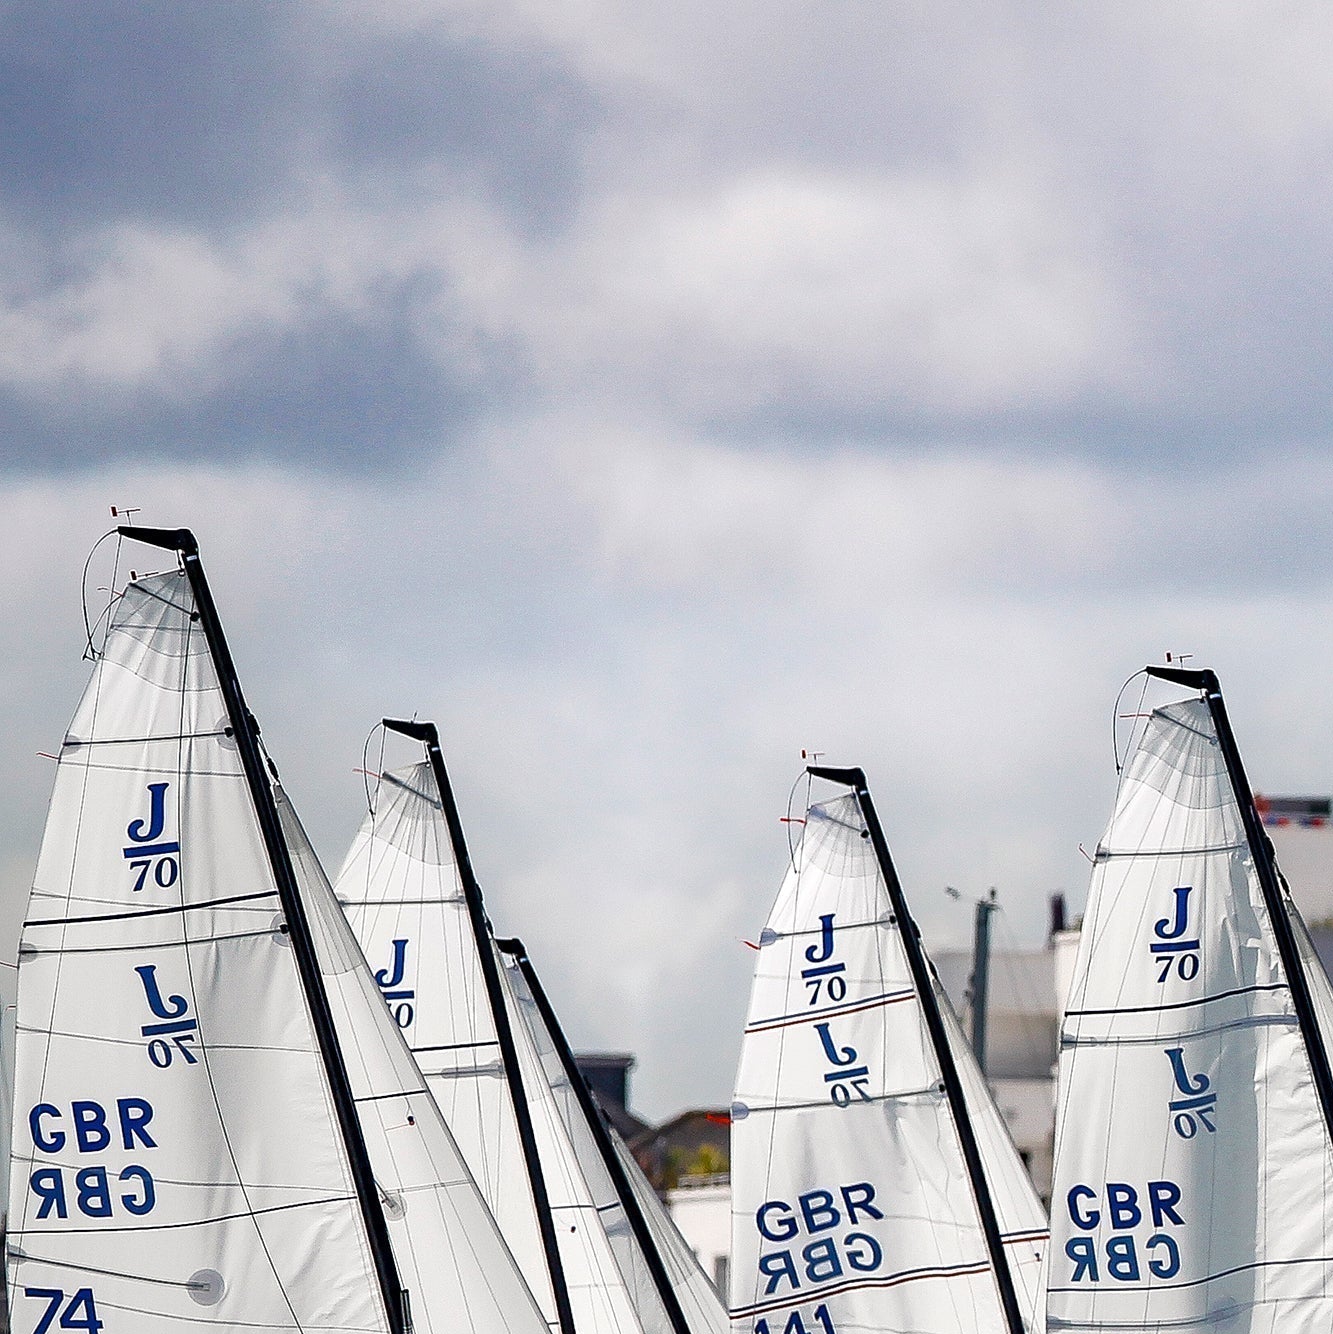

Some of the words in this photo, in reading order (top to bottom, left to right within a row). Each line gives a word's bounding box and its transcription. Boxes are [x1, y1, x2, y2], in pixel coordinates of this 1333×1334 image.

[127, 782, 170, 842] J
[129, 857, 178, 892] 70
[1154, 887, 1192, 939] J
[805, 913, 836, 963] J
[375, 939, 409, 987] J
[1154, 953, 1199, 983] 70
[805, 976, 847, 1005] 70
[387, 1003, 414, 1029] 0
[28, 1098, 158, 1153] GBR
[755, 1181, 884, 1242] GBR
[1067, 1181, 1186, 1230] GBR
